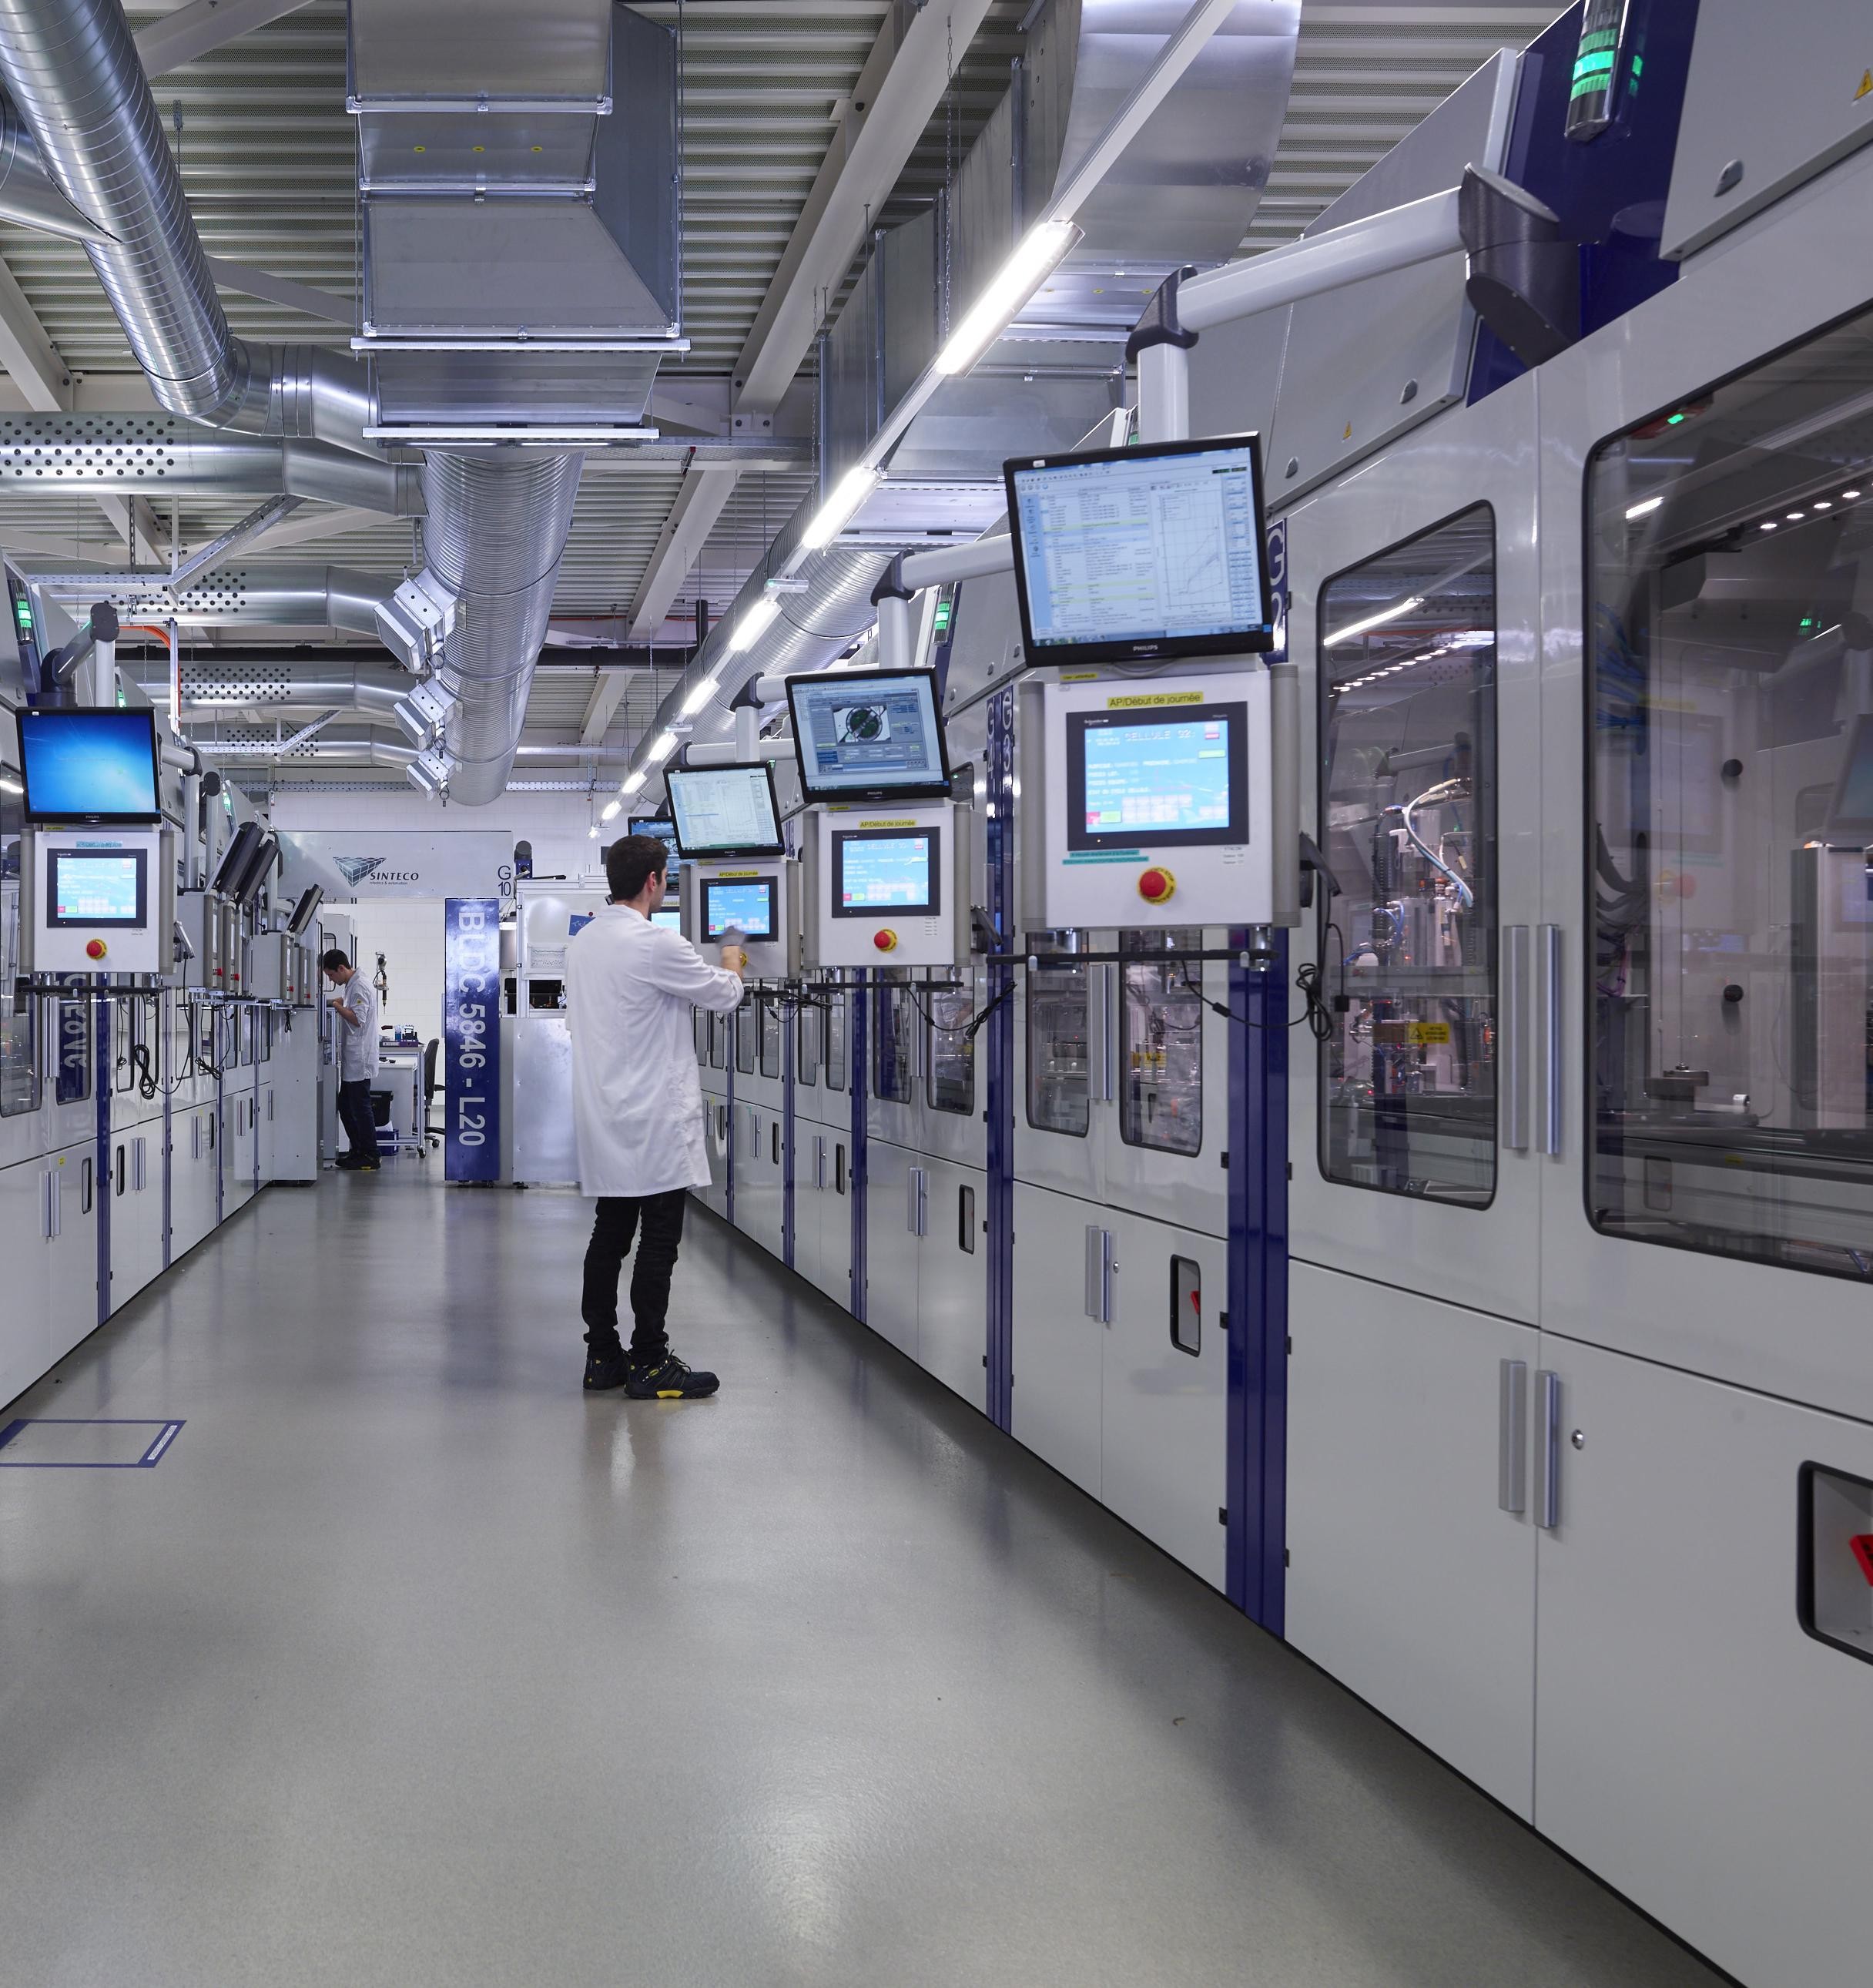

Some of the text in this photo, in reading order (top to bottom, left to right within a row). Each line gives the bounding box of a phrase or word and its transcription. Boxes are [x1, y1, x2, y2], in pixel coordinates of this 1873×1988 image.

[1267, 528, 1285, 586] G
[1002, 692, 1012, 731] G
[1109, 694, 1201, 707] AP/Début de journée
[987, 702, 994, 739] G
[987, 743, 994, 779] 4
[1004, 733, 1011, 772] 3
[370, 872, 419, 880] SINTECO
[498, 865, 511, 880] G
[498, 881, 511, 896] 10
[459, 912, 486, 993] BLDC
[459, 1003, 486, 1068] 5846
[459, 1097, 486, 1146] L20
